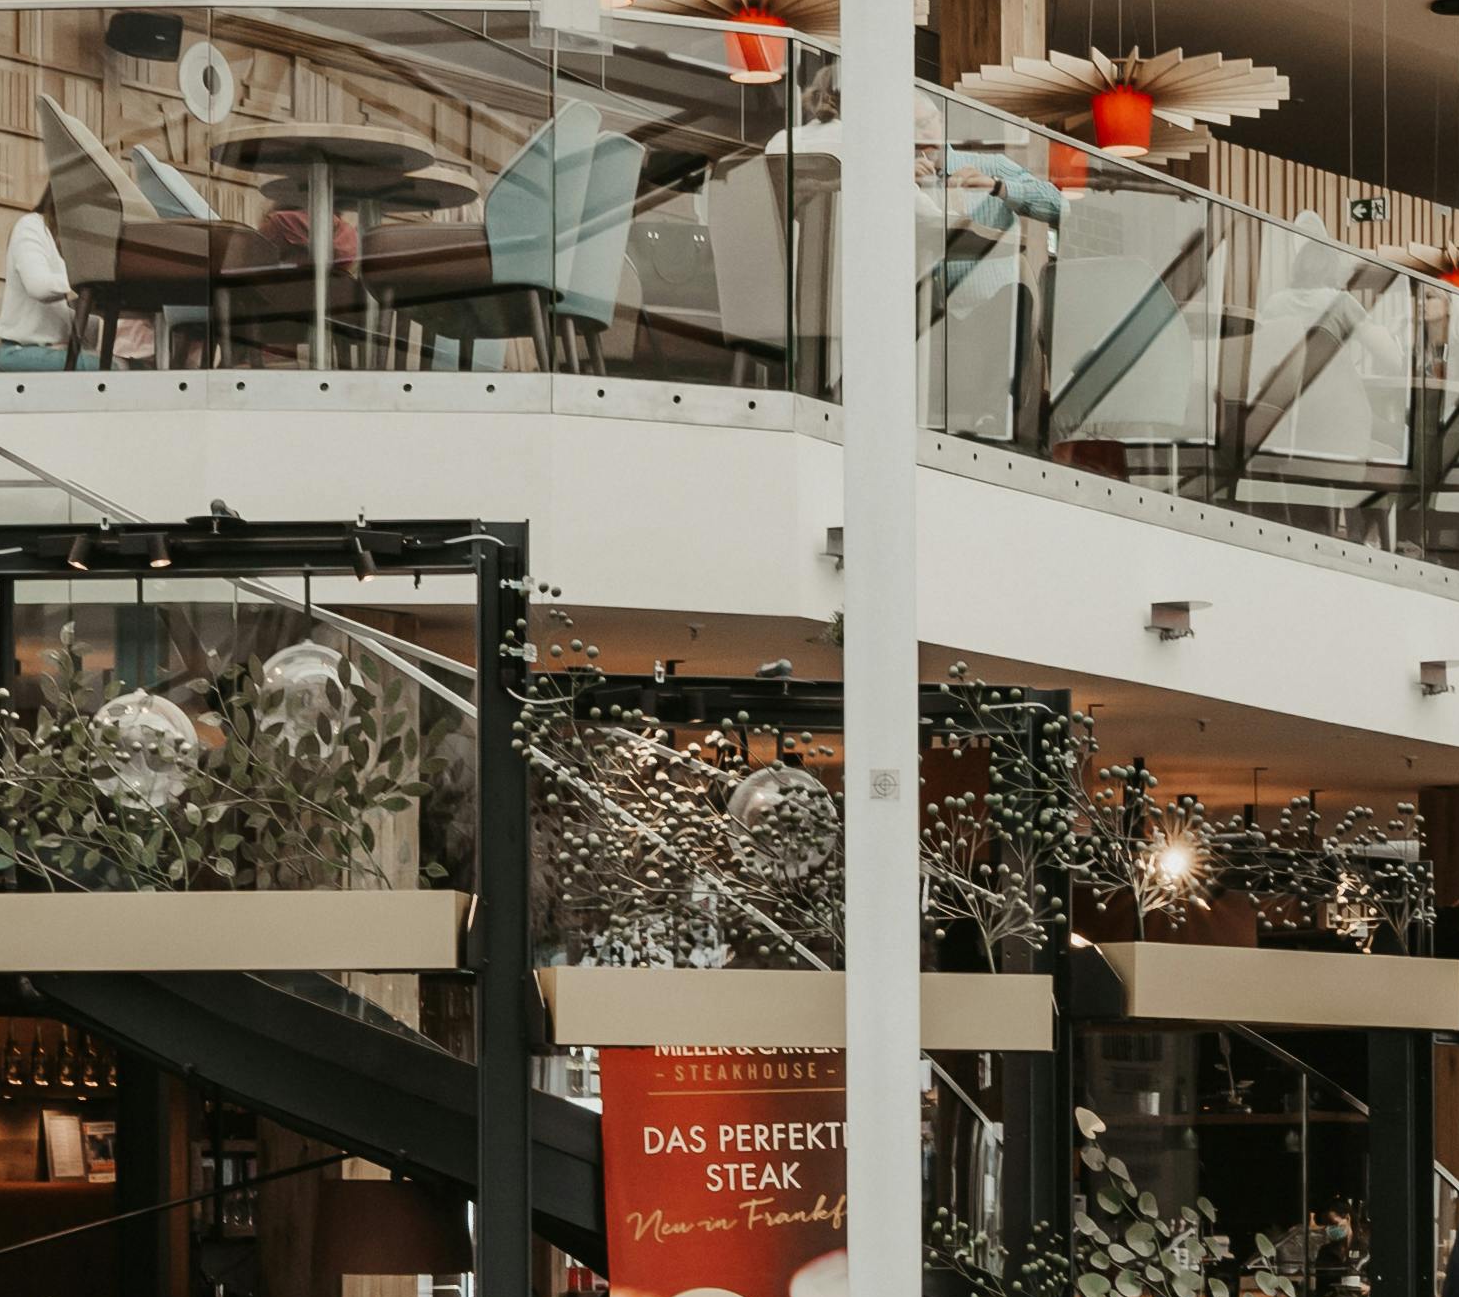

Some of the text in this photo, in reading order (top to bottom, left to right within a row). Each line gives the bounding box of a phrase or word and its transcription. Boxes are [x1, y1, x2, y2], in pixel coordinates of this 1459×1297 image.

[675, 1063, 817, 1082] STEAKHOUSE
[643, 1121, 847, 1154] DAS PERFEKT
[706, 1161, 802, 1192] STEAK
[626, 1209, 694, 1243] Neu
[696, 1215, 738, 1232] in
